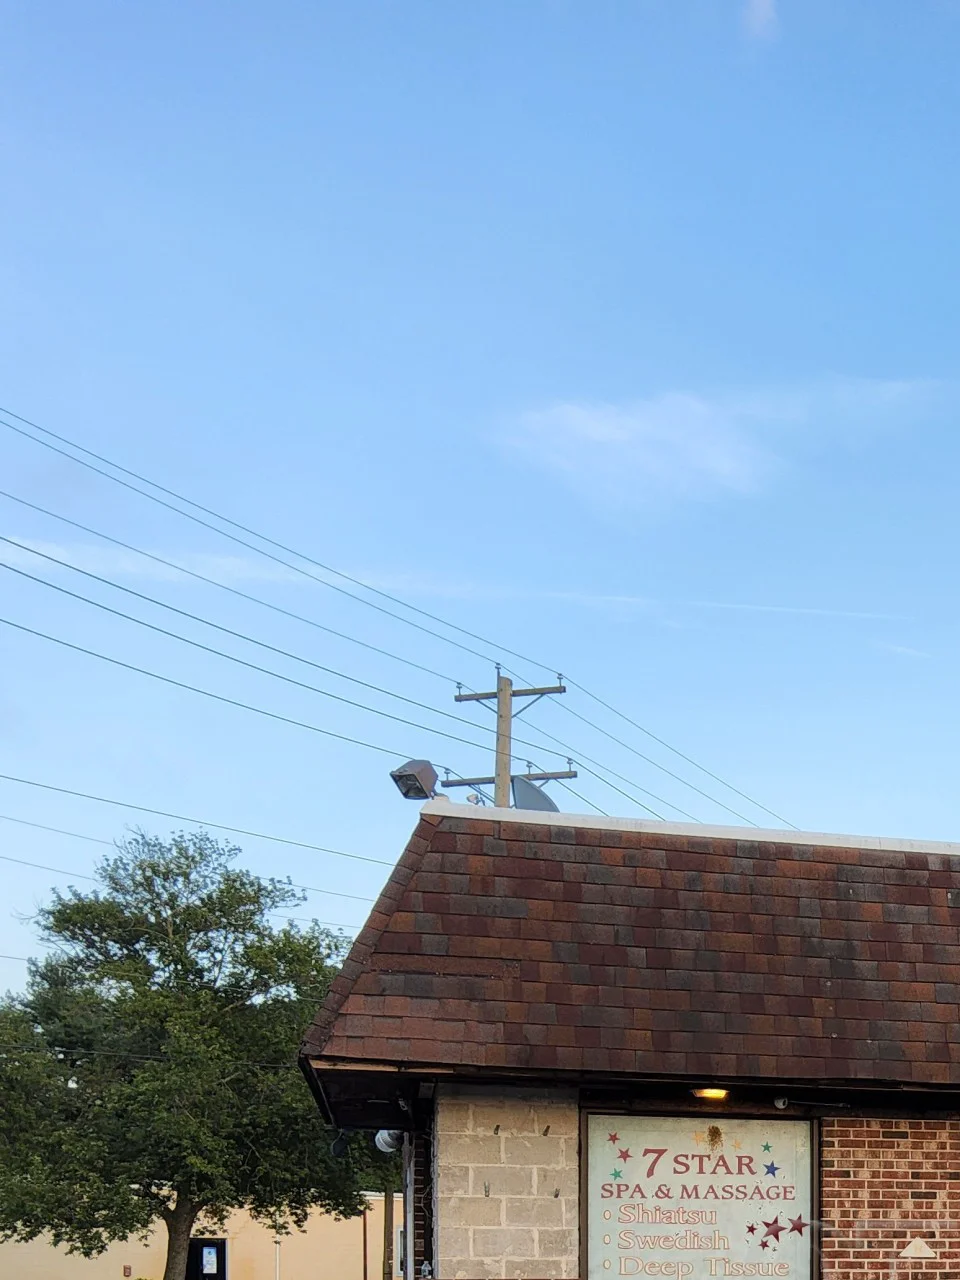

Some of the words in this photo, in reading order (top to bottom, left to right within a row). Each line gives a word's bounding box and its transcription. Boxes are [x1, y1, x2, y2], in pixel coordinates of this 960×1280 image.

[642, 1148, 668, 1178] 7
[673, 1154, 757, 1176] STAR
[600, 1183, 646, 1199] SPA
[654, 1184, 673, 1199] &
[680, 1185, 795, 1201] MASSAGE
[617, 1203, 717, 1225] Shiatsu
[617, 1229, 730, 1250] Swedish
[704, 1257, 790, 1277] Tissue
